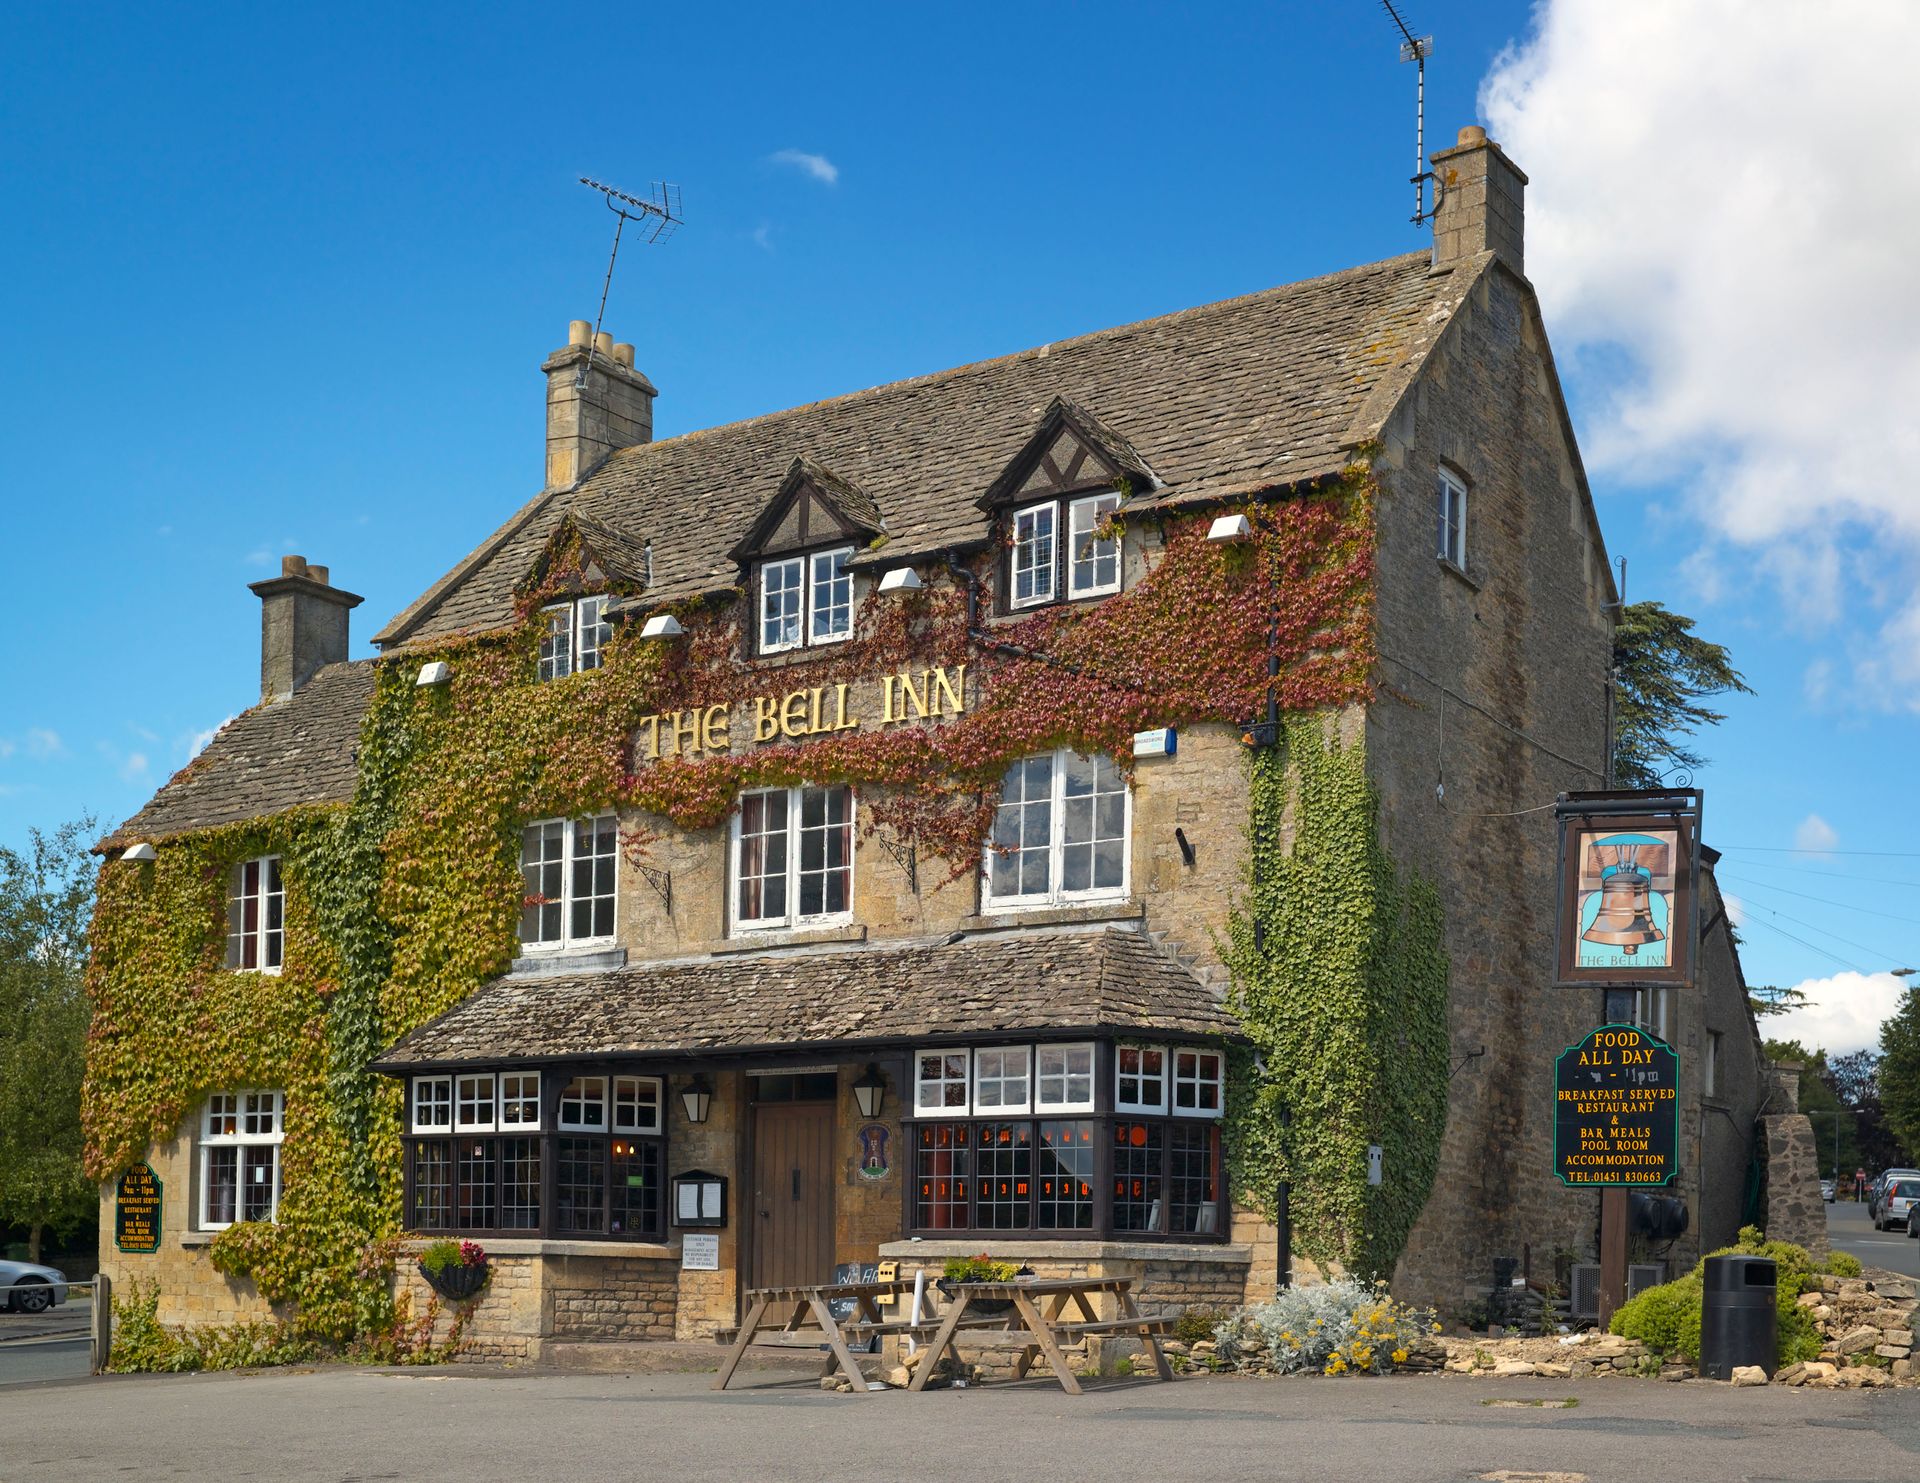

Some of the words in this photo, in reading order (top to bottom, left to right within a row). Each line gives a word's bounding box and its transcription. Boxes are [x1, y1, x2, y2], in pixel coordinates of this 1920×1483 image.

[639, 702, 731, 760] THE
[752, 683, 860, 743] BELL
[880, 664, 967, 724] INN
[1579, 955, 1604, 966] THE
[1610, 955, 1641, 966] BELL
[1646, 955, 1669, 966] INN
[1594, 1032, 1640, 1048] FOOD
[1578, 1051, 1612, 1065] ALL
[1622, 1049, 1655, 1064] DAY
[1558, 1089, 1625, 1101] BREAKFAST
[1630, 1089, 1675, 1100] SERVED
[1577, 1101, 1655, 1113] RESTAURANT
[1611, 1114, 1619, 1125] &
[1580, 1128, 1604, 1139] BAR
[1609, 1127, 1651, 1138] MEALS
[1581, 1140, 1610, 1150] POOL
[1616, 1140, 1648, 1151] ROOM
[1565, 1155, 1664, 1165] ACCOMMODATION
[125, 1175, 137, 1184] ALL
[140, 1175, 153, 1184] DAY
[1625, 1171, 1661, 1182] 830663
